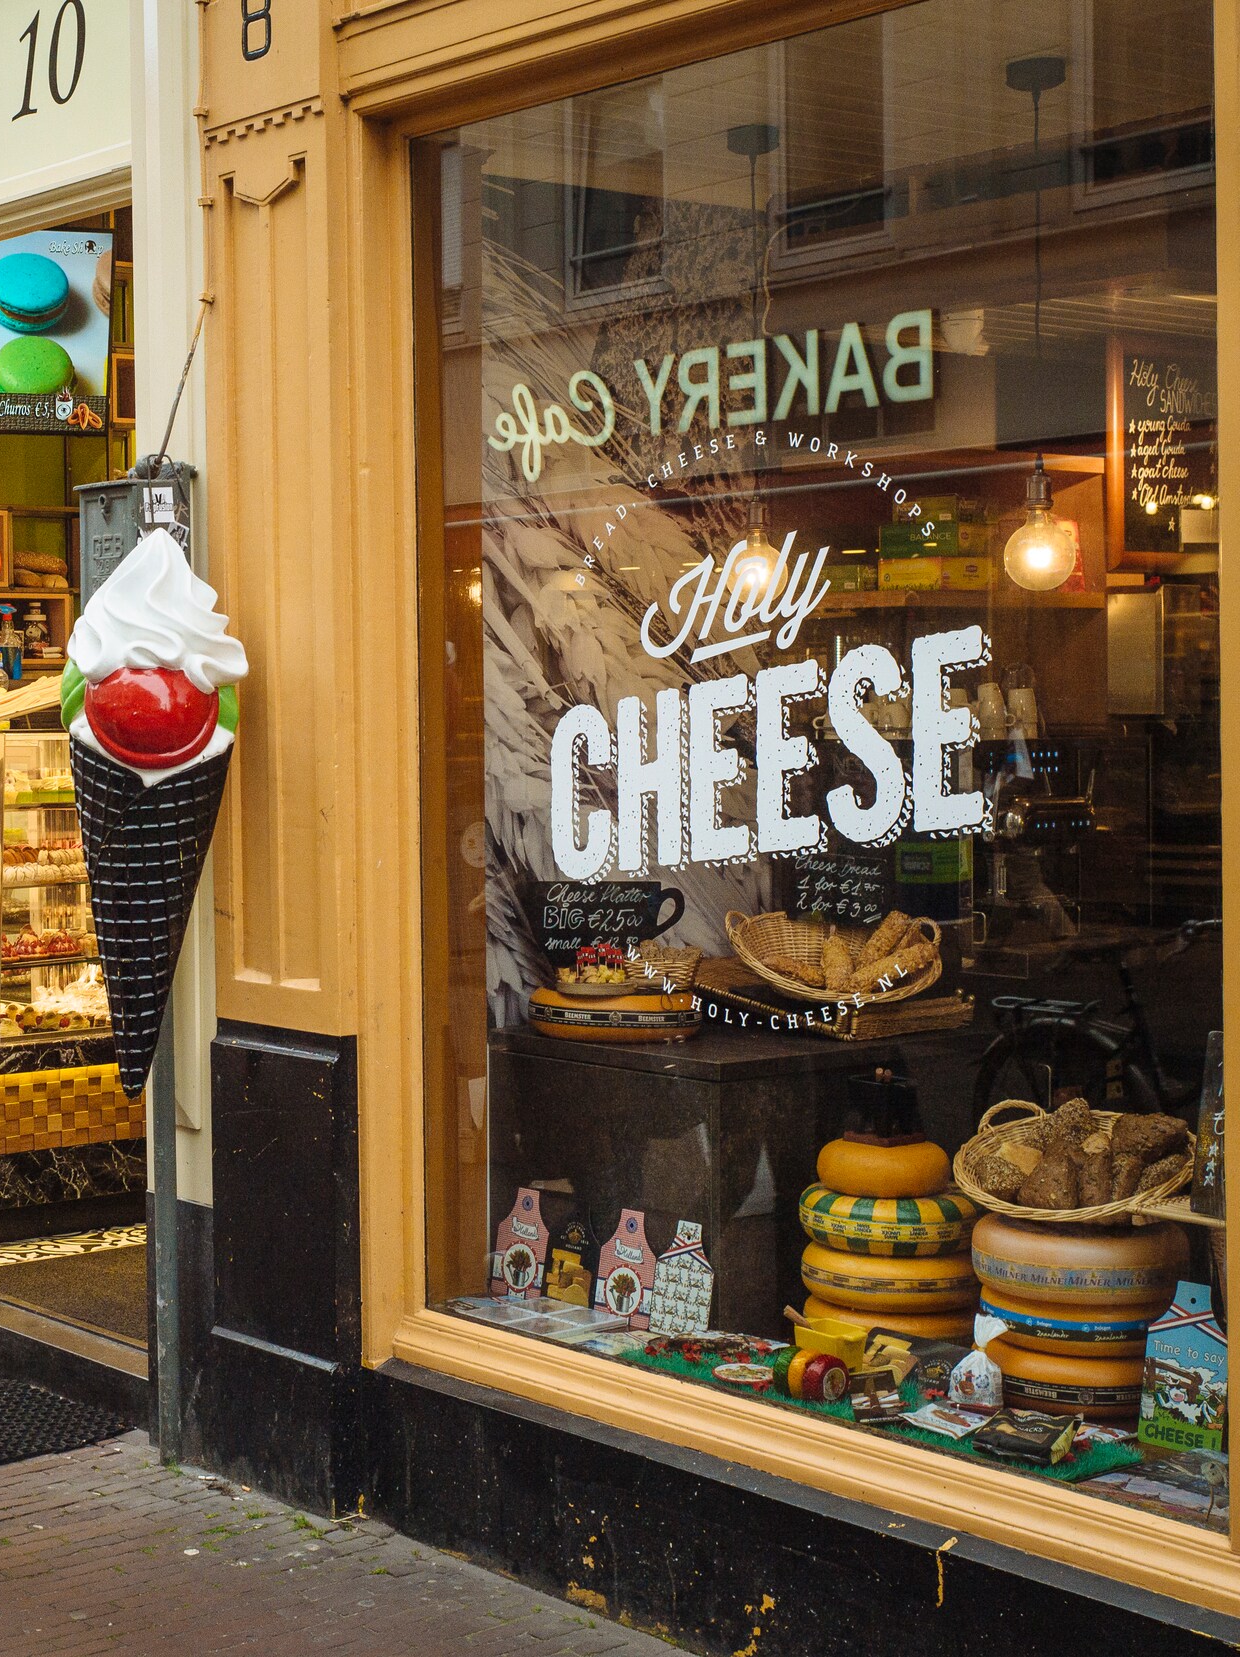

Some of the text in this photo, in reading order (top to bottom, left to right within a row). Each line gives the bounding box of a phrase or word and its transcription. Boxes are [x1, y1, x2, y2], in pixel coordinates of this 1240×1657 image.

[241, 0, 271, 61] 8
[12, 0, 85, 122] 10
[1129, 359, 1159, 406] Holy
[1137, 415, 1192, 444] young Gouda
[1137, 438, 1186, 465] aged Gouda
[647, 430, 936, 538] CHEESE & WORKSHOPS
[1137, 458, 1189, 490] goat cheese
[1140, 483, 1198, 507] Old Amsterd
[910, 531, 951, 542] BALANCE
[640, 530, 831, 660] Holy
[551, 625, 993, 885] CHEESE
[795, 855, 838, 874] Cheese
[546, 883, 651, 904] Cheese Platter
[814, 876, 837, 895] for
[796, 892, 808, 910] 2
[811, 896, 833, 916] for
[545, 936, 581, 951] small
[565, 1011, 665, 1022] BEEMSTER BEEMSTER
[995, 1265, 1027, 1282] MILNER
[1067, 1275, 1112, 1287] MILNER
[1036, 1329, 1128, 1342] Zaanlander Zaanlander
[1154, 1339, 1226, 1367] Time to say
[1144, 1422, 1205, 1449] CHEESE
